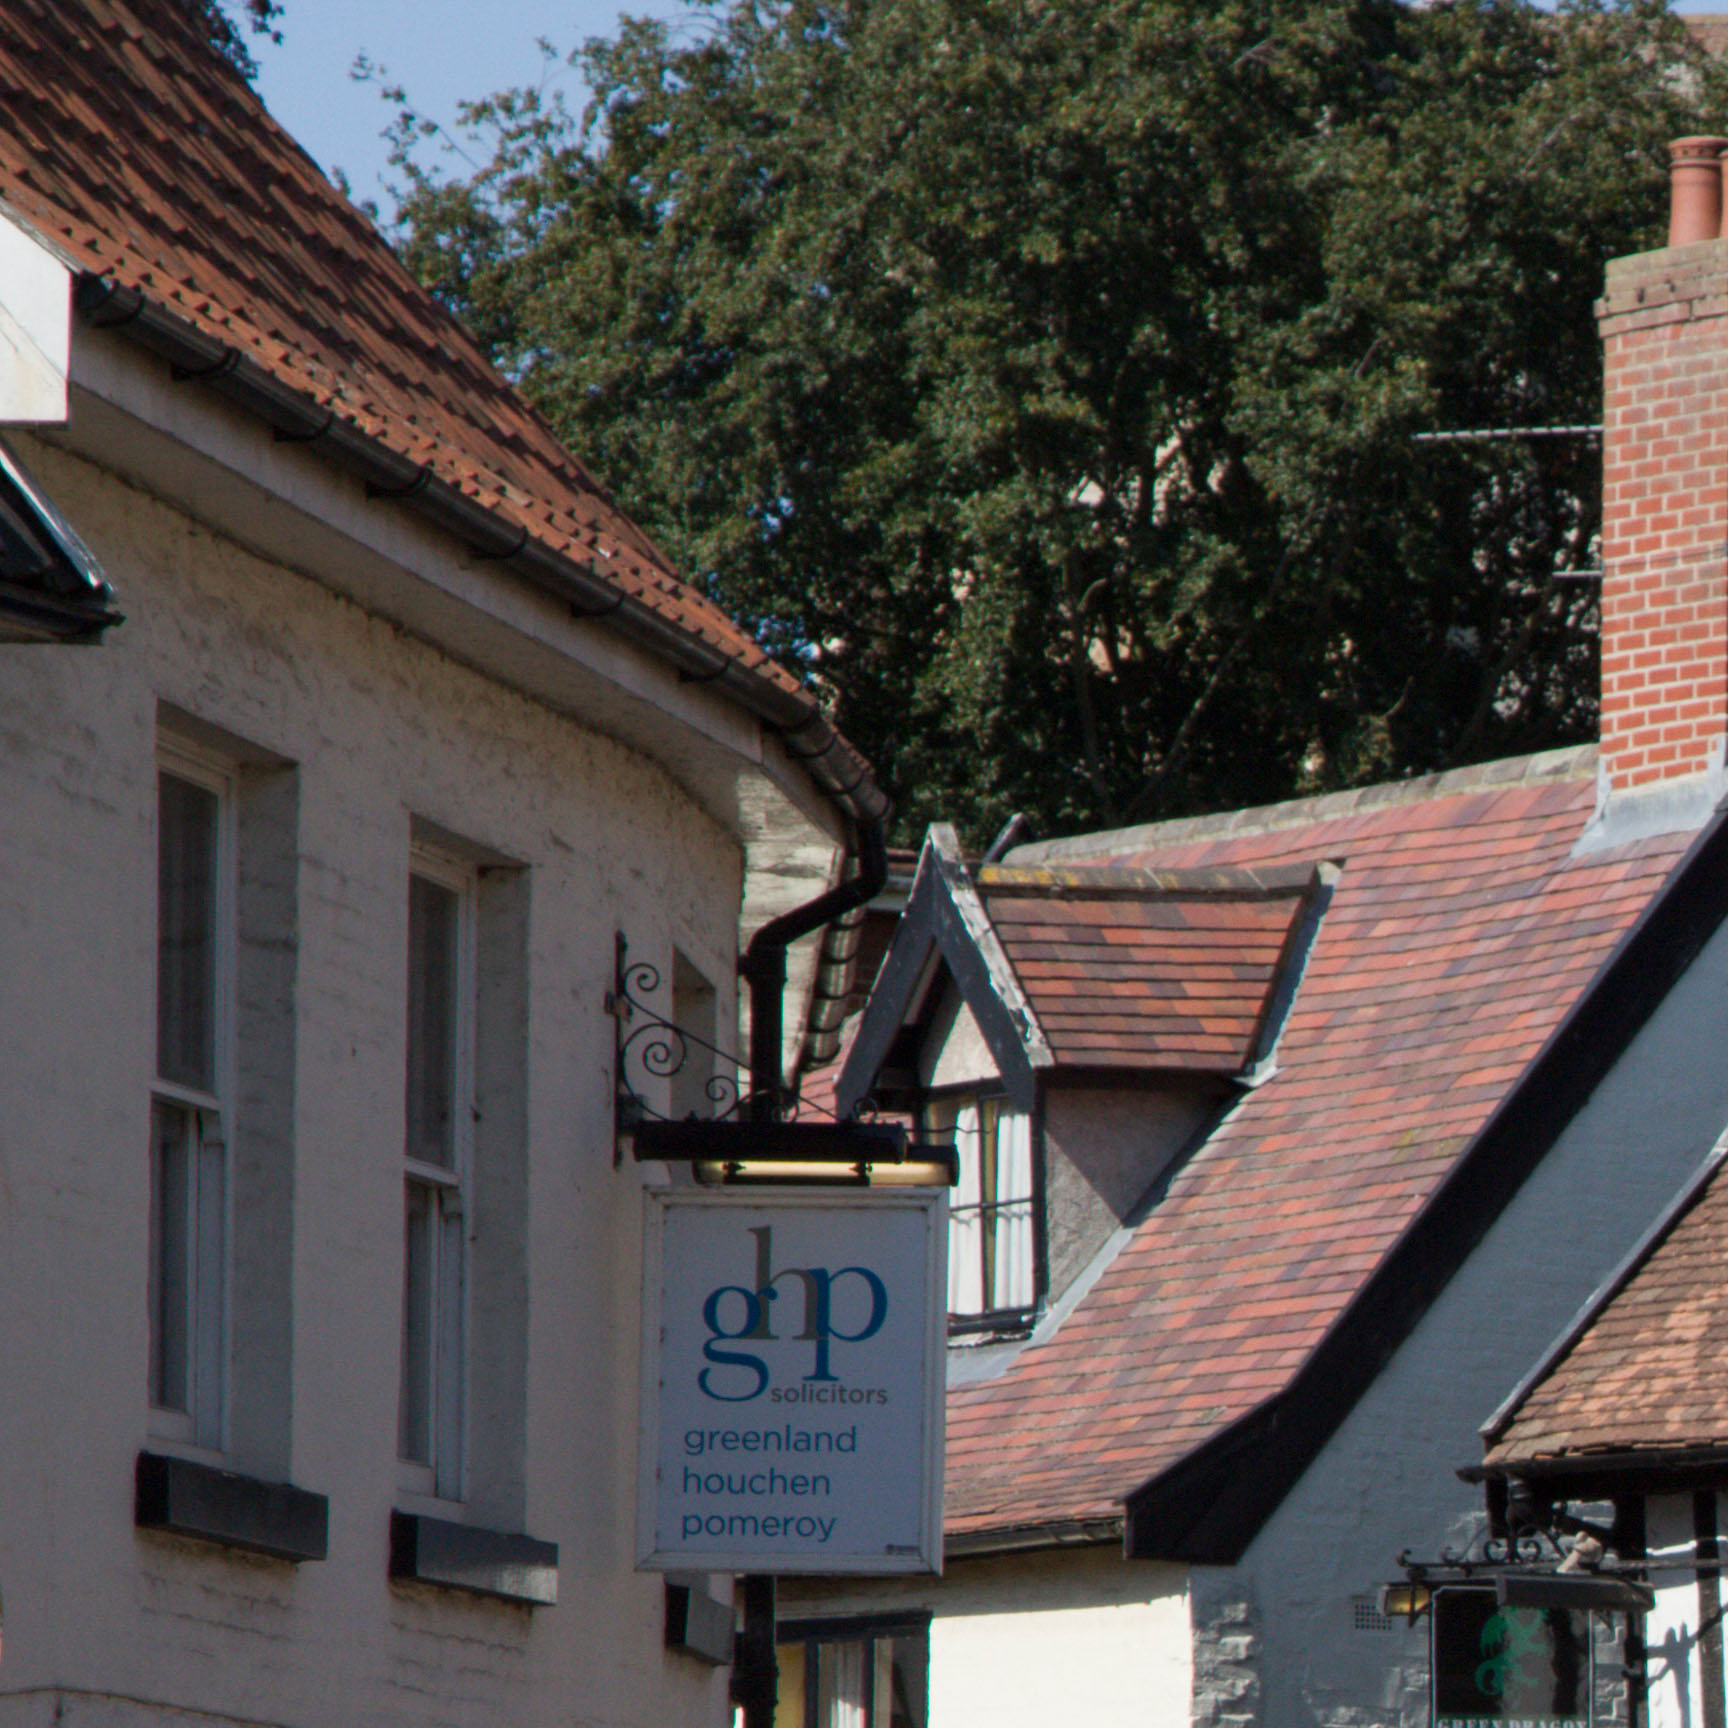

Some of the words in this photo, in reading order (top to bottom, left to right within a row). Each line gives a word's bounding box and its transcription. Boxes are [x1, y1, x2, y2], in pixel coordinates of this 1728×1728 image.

[697, 1225, 889, 1402] ghp
[770, 1383, 889, 1405] solicitors
[683, 1424, 857, 1455] greenland
[681, 1466, 831, 1495] houchen
[681, 1513, 837, 1542] pomeroy
